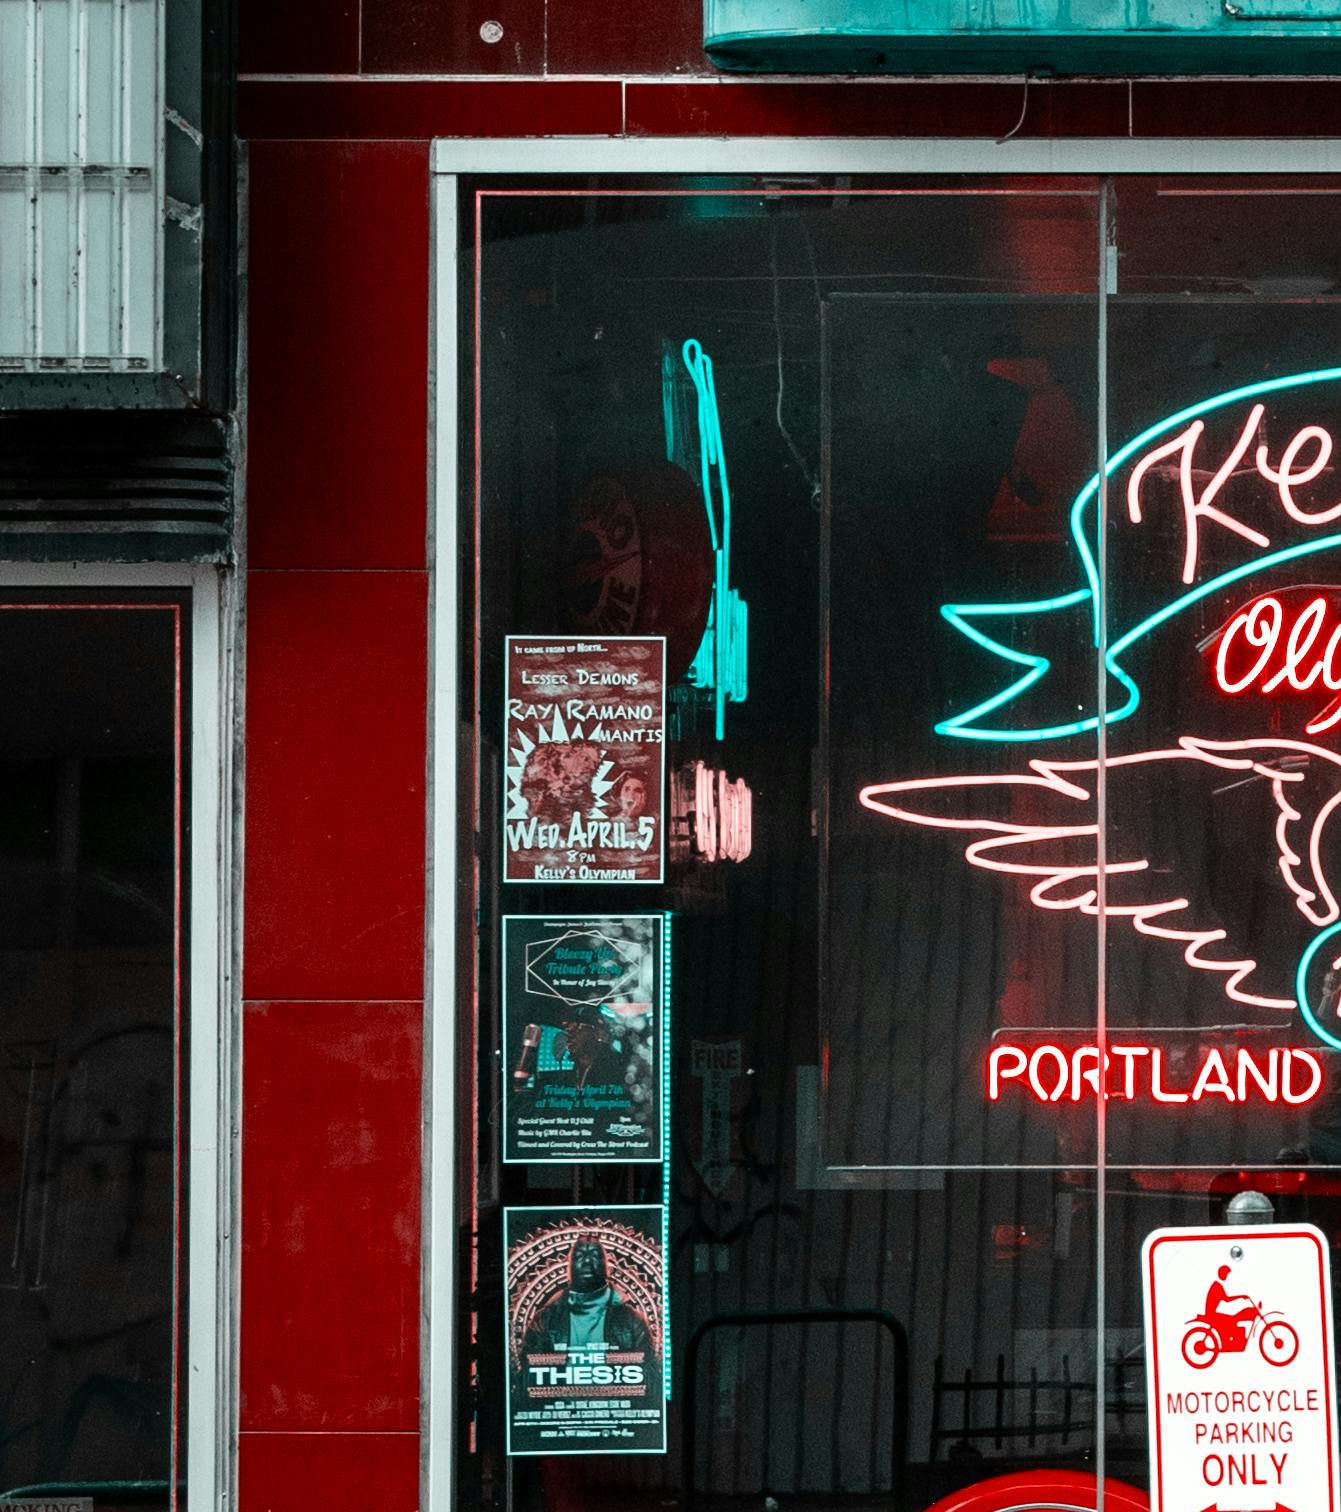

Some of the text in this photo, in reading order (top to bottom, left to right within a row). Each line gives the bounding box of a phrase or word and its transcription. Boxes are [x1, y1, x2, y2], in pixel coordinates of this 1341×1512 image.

[521, 669, 639, 685] LESSER DEMONS
[508, 698, 653, 722] RAY RAMANO
[600, 728, 663, 743] MANTIS
[566, 850, 596, 863] 8 PM
[534, 865, 636, 880] KELLY'S OLYMPIAN
[988, 1044, 1323, 1104] PORTLAND
[568, 1352, 605, 1365] THE
[529, 1365, 644, 1386] THESIS
[1166, 1389, 1319, 1414] MOTORCYCLE
[1195, 1421, 1293, 1444] PARKING
[1202, 1453, 1288, 1487] ONLY
